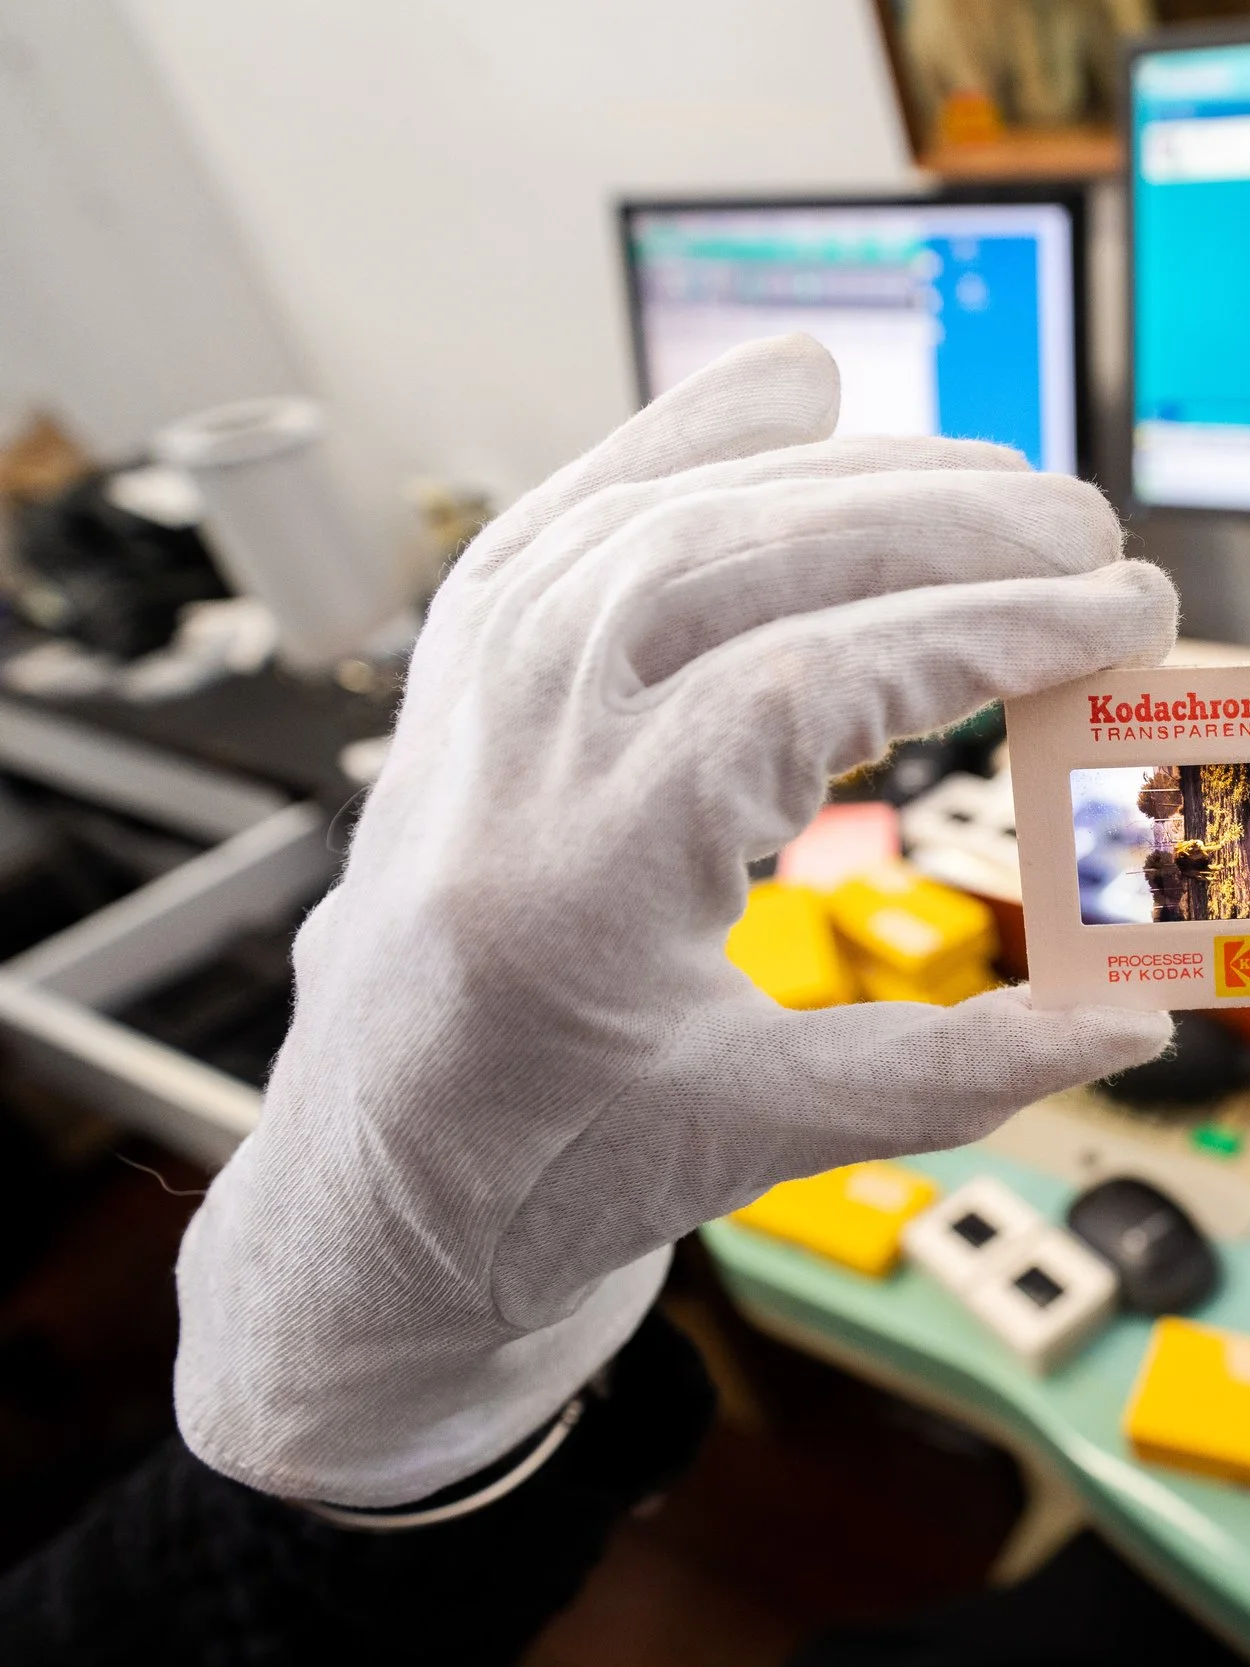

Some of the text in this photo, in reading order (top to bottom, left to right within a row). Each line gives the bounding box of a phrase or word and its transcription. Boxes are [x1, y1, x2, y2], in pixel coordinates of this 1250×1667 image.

[1107, 953, 1204, 968] PROCESSED
[1108, 967, 1205, 983] BY KODAK
